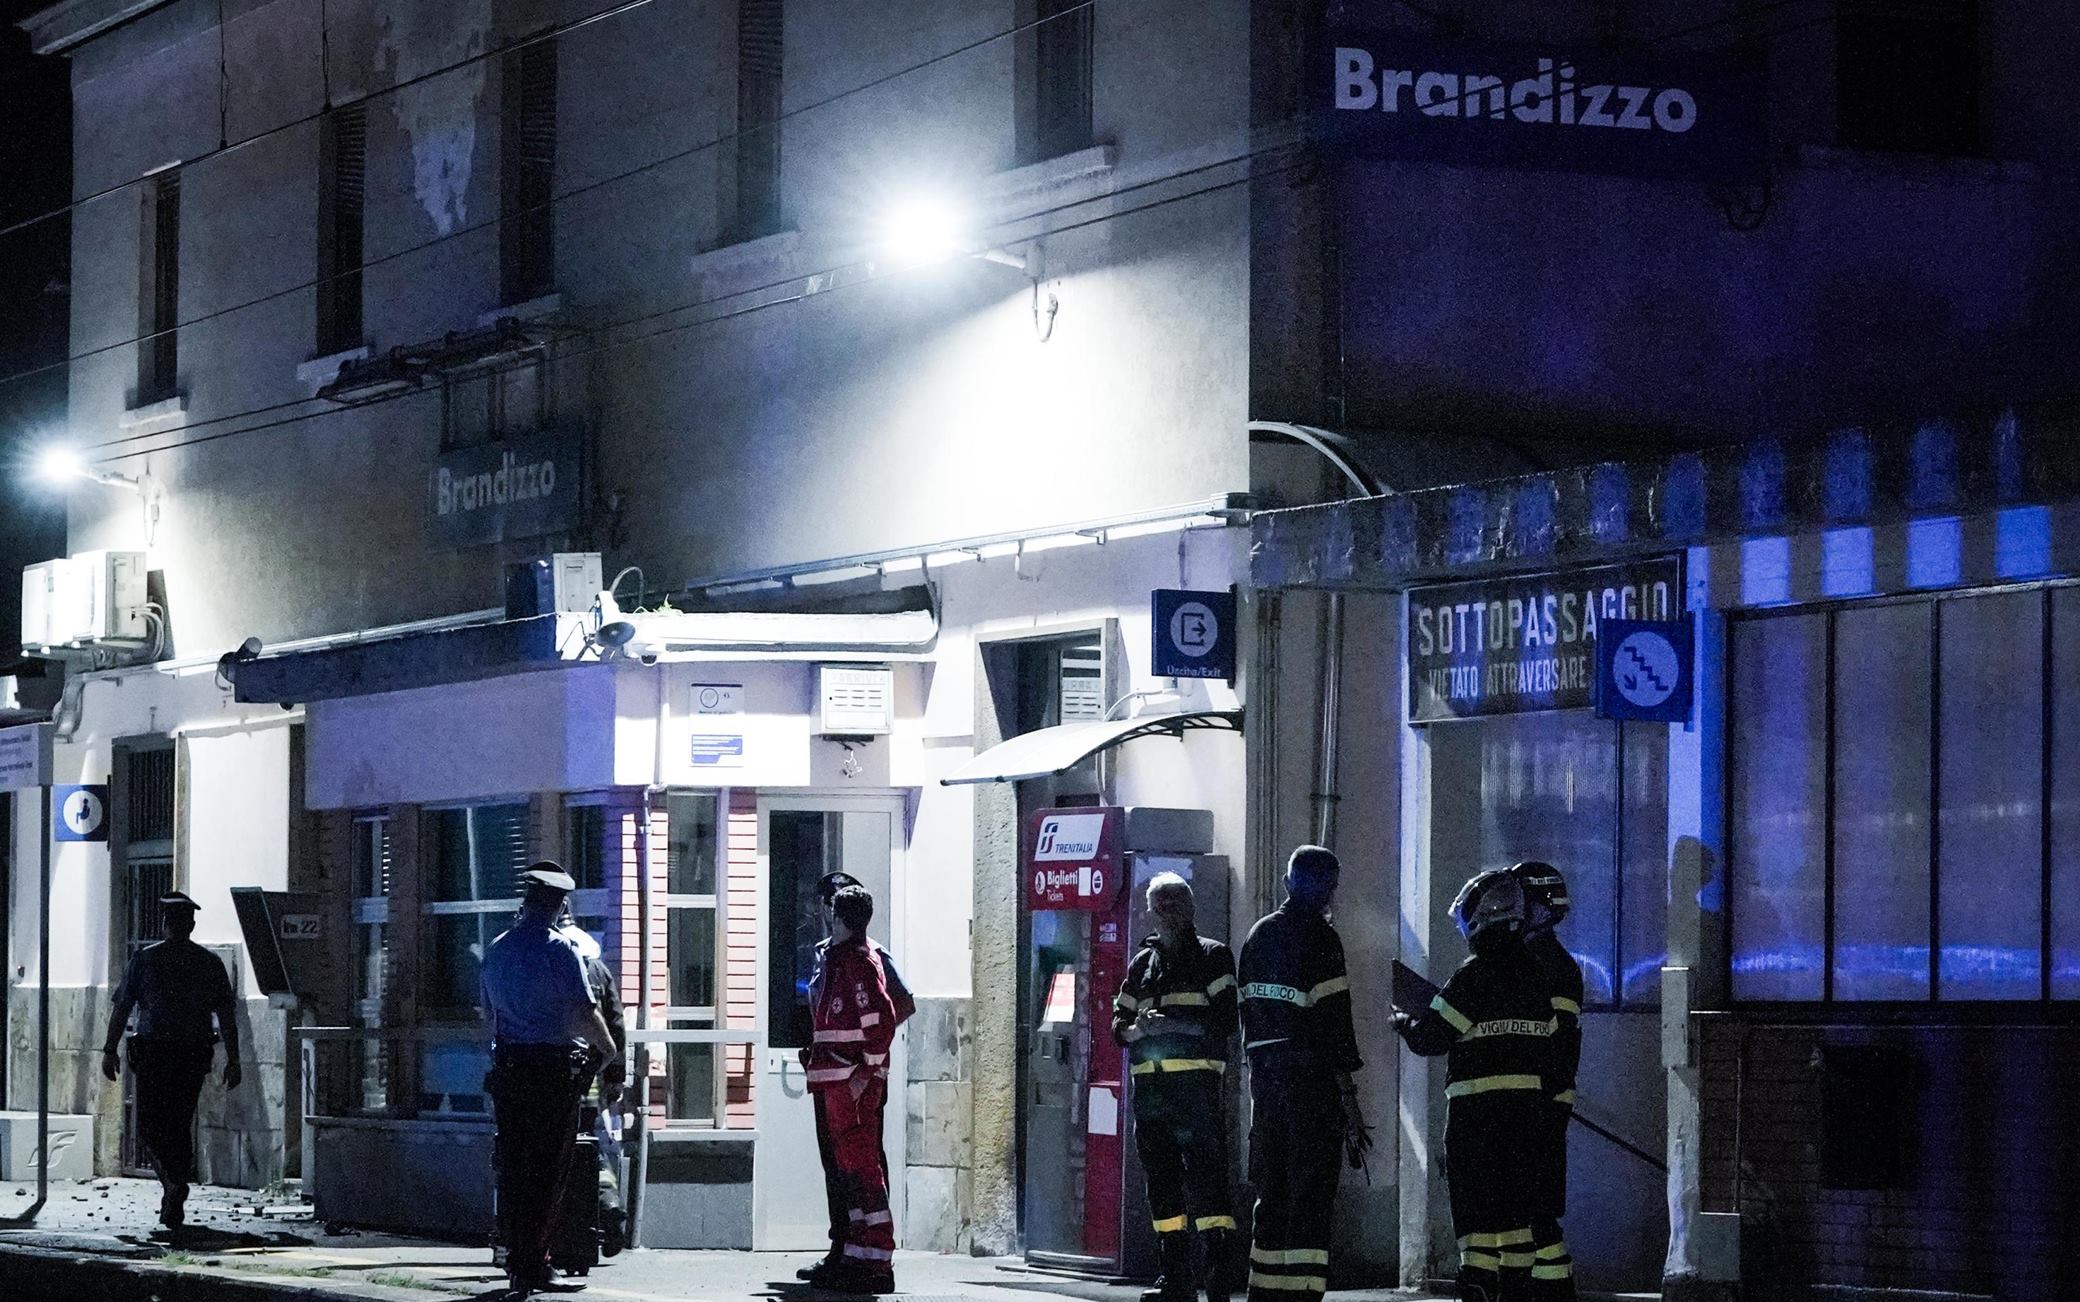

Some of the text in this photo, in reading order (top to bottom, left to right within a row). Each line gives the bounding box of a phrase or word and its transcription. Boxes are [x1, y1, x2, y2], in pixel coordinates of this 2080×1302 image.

[1335, 46, 1697, 133] Brandizzo
[438, 451, 556, 515] Brandizzo
[1418, 581, 1668, 655] SOTTOPASSAGGIO
[1167, 664, 1221, 677] Uscita/Exit
[1428, 656, 1587, 699] VIETATO ATTRAVERSARE
[1055, 843, 1093, 854] TRENITALIA
[1047, 870, 1079, 889] Biglietti
[1511, 1021, 1532, 1033] DEL
